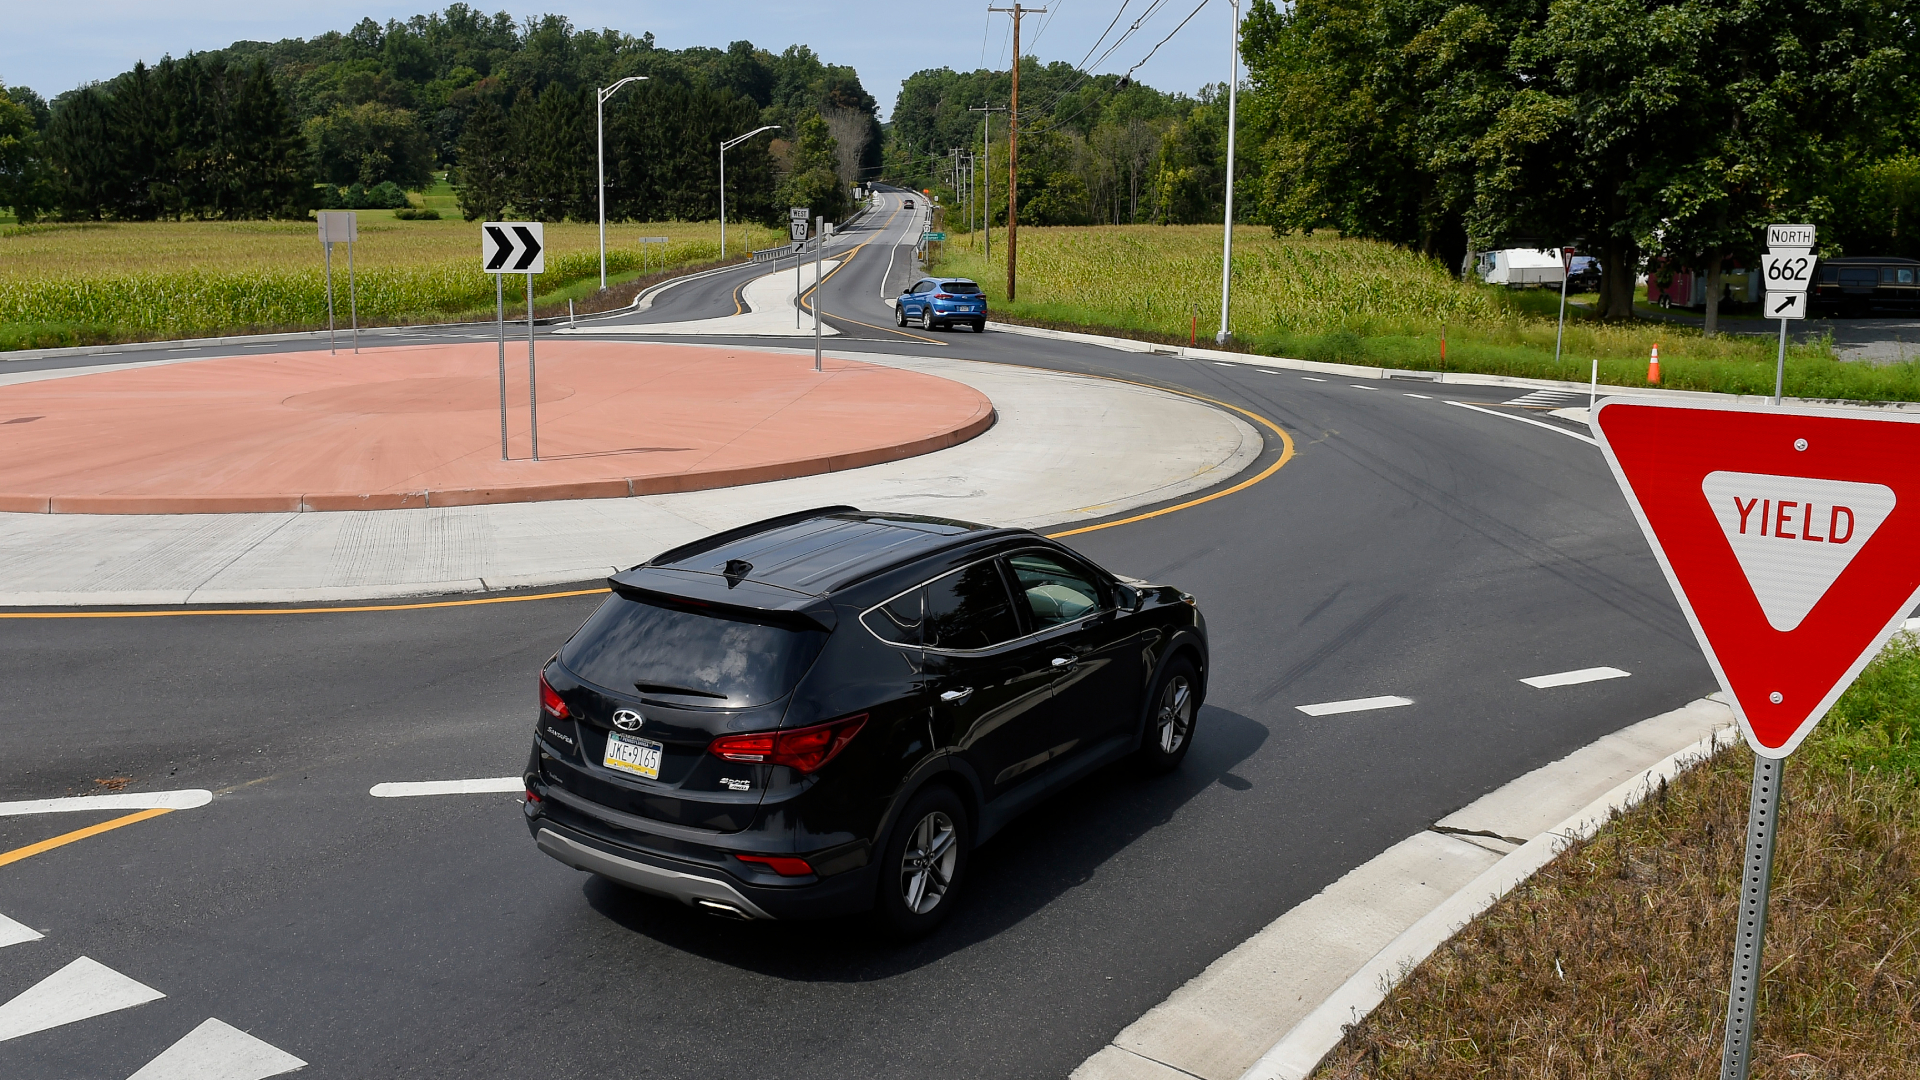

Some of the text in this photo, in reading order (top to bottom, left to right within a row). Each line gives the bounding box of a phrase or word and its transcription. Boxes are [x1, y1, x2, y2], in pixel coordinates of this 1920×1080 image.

[794, 224, 804, 235] 73
[1771, 229, 1811, 243] NORTH
[1768, 258, 1808, 281] 662
[1733, 496, 1855, 544] YIELD
